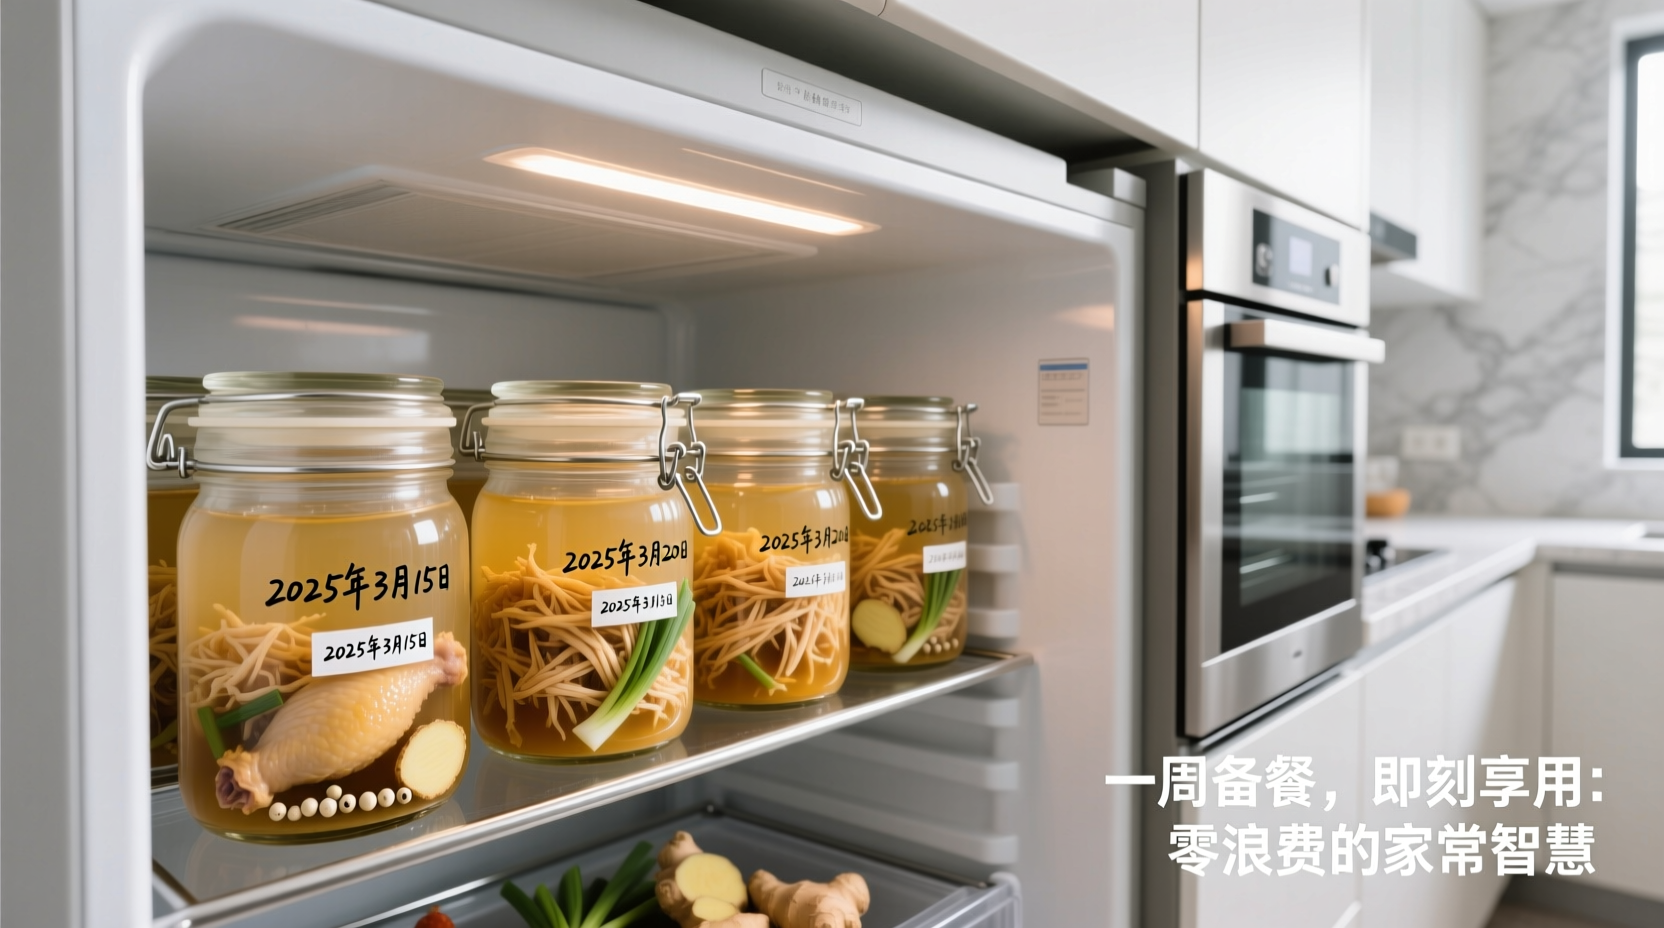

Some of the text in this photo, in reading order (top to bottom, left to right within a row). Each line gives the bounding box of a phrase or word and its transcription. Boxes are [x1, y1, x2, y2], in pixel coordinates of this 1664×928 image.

[562, 538, 688, 577] 2025年3月20日
[265, 562, 449, 611] 2025年3月15日
[323, 631, 427, 661] 2025年3月15日
